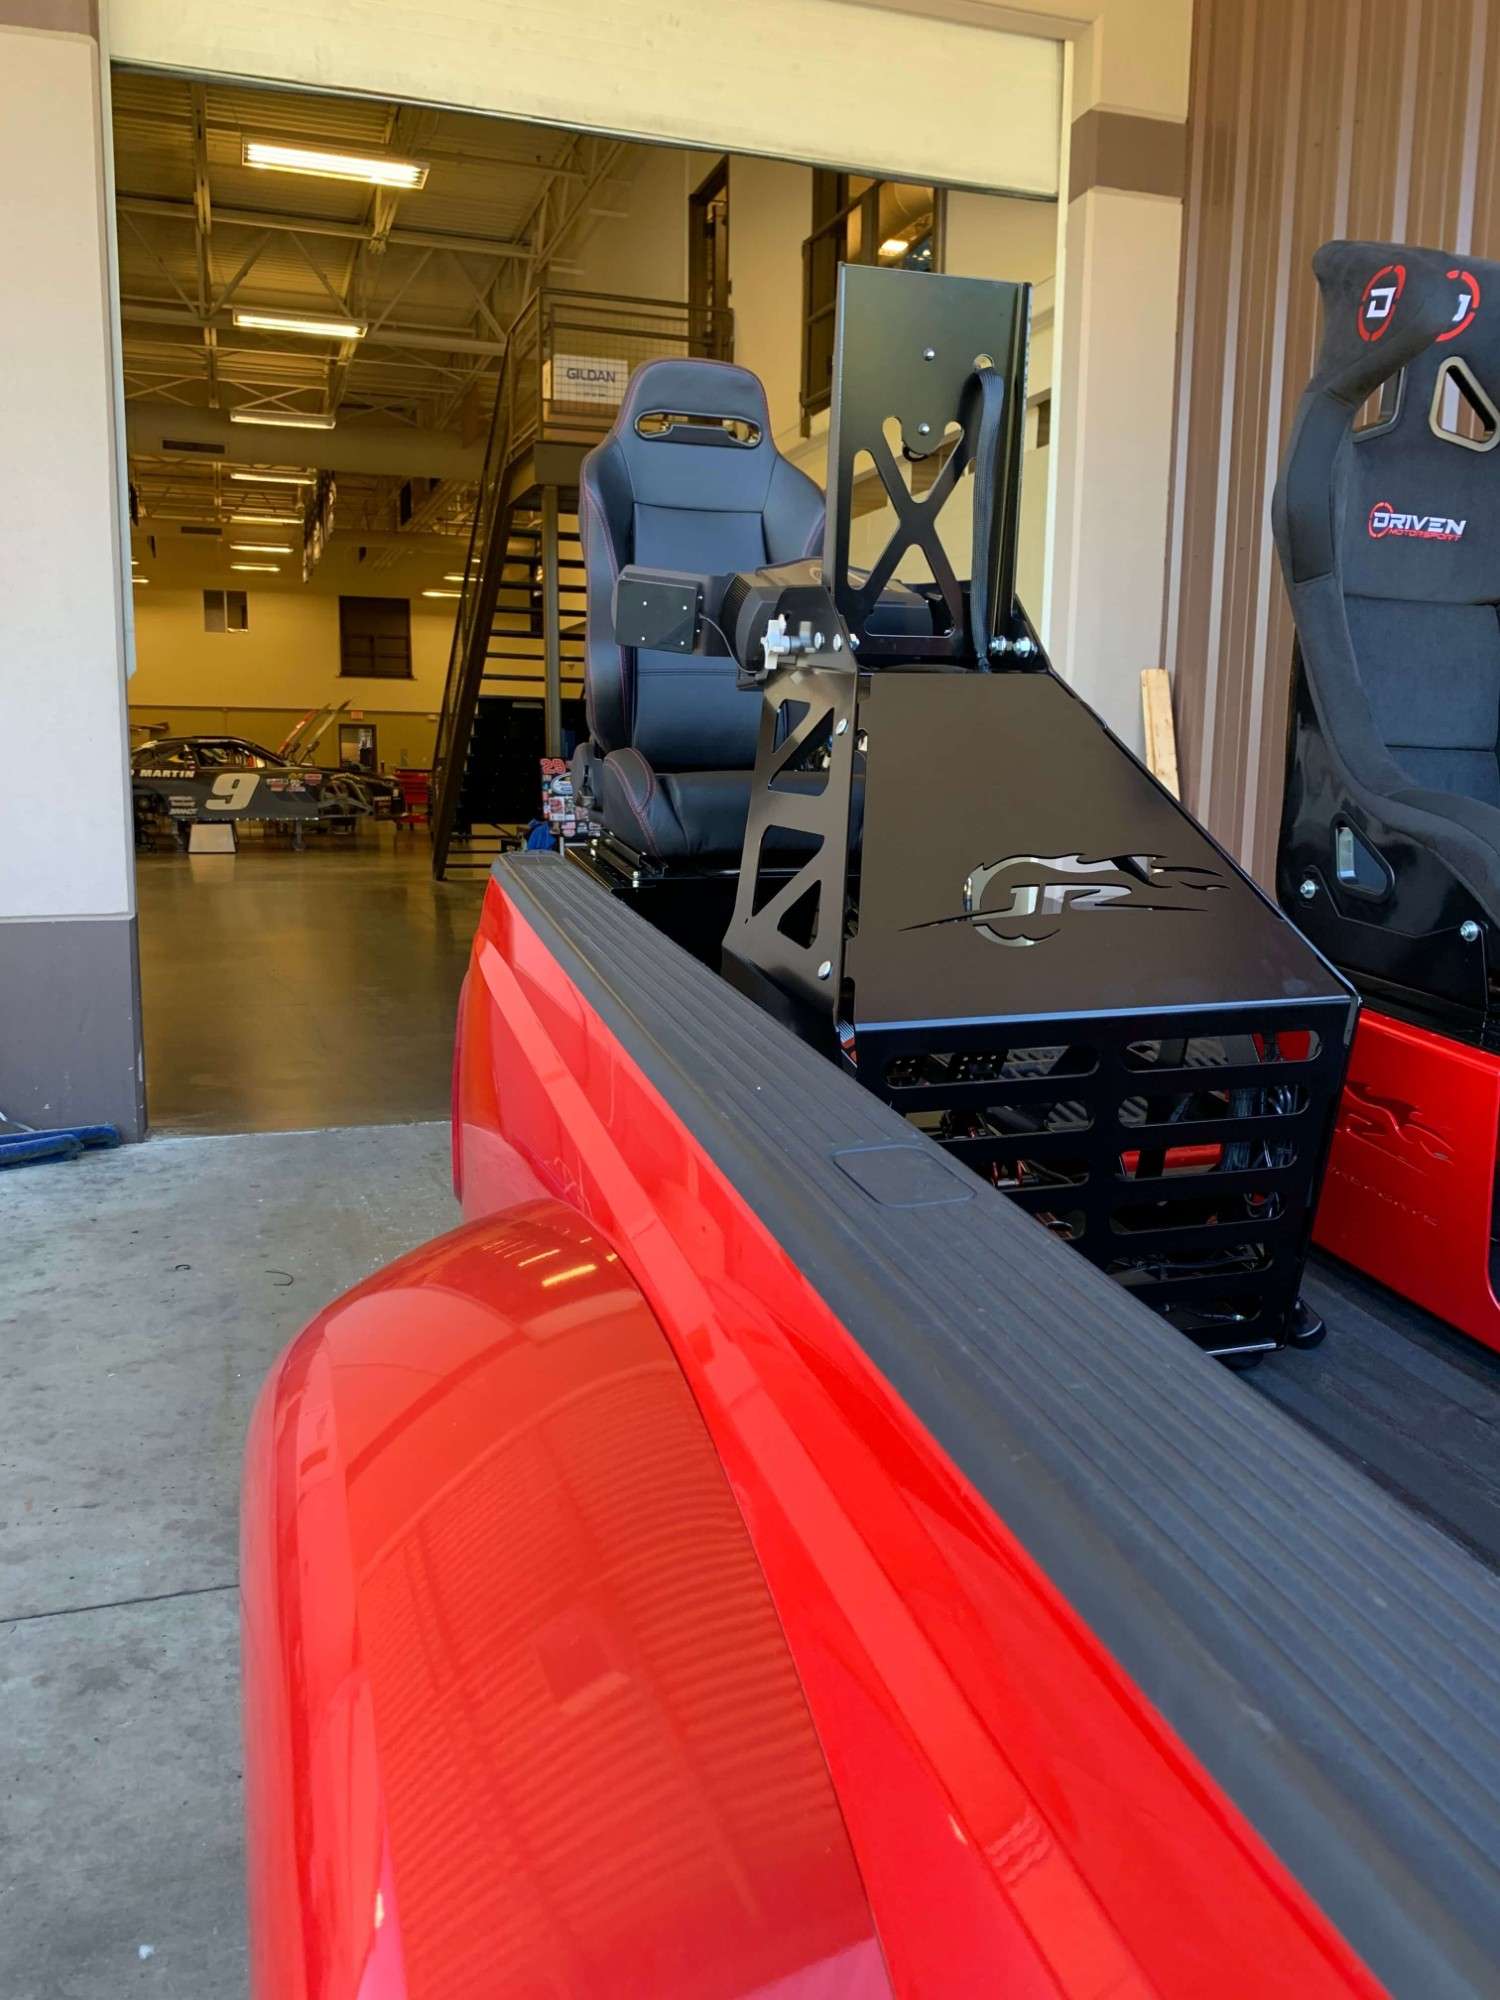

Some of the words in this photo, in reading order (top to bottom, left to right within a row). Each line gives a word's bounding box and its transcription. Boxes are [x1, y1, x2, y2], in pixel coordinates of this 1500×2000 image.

[566, 367, 616, 383] GILDAN
[1373, 511, 1467, 536] DRIVEN
[139, 769, 195, 778] MARTIN
[205, 772, 261, 811] 9
